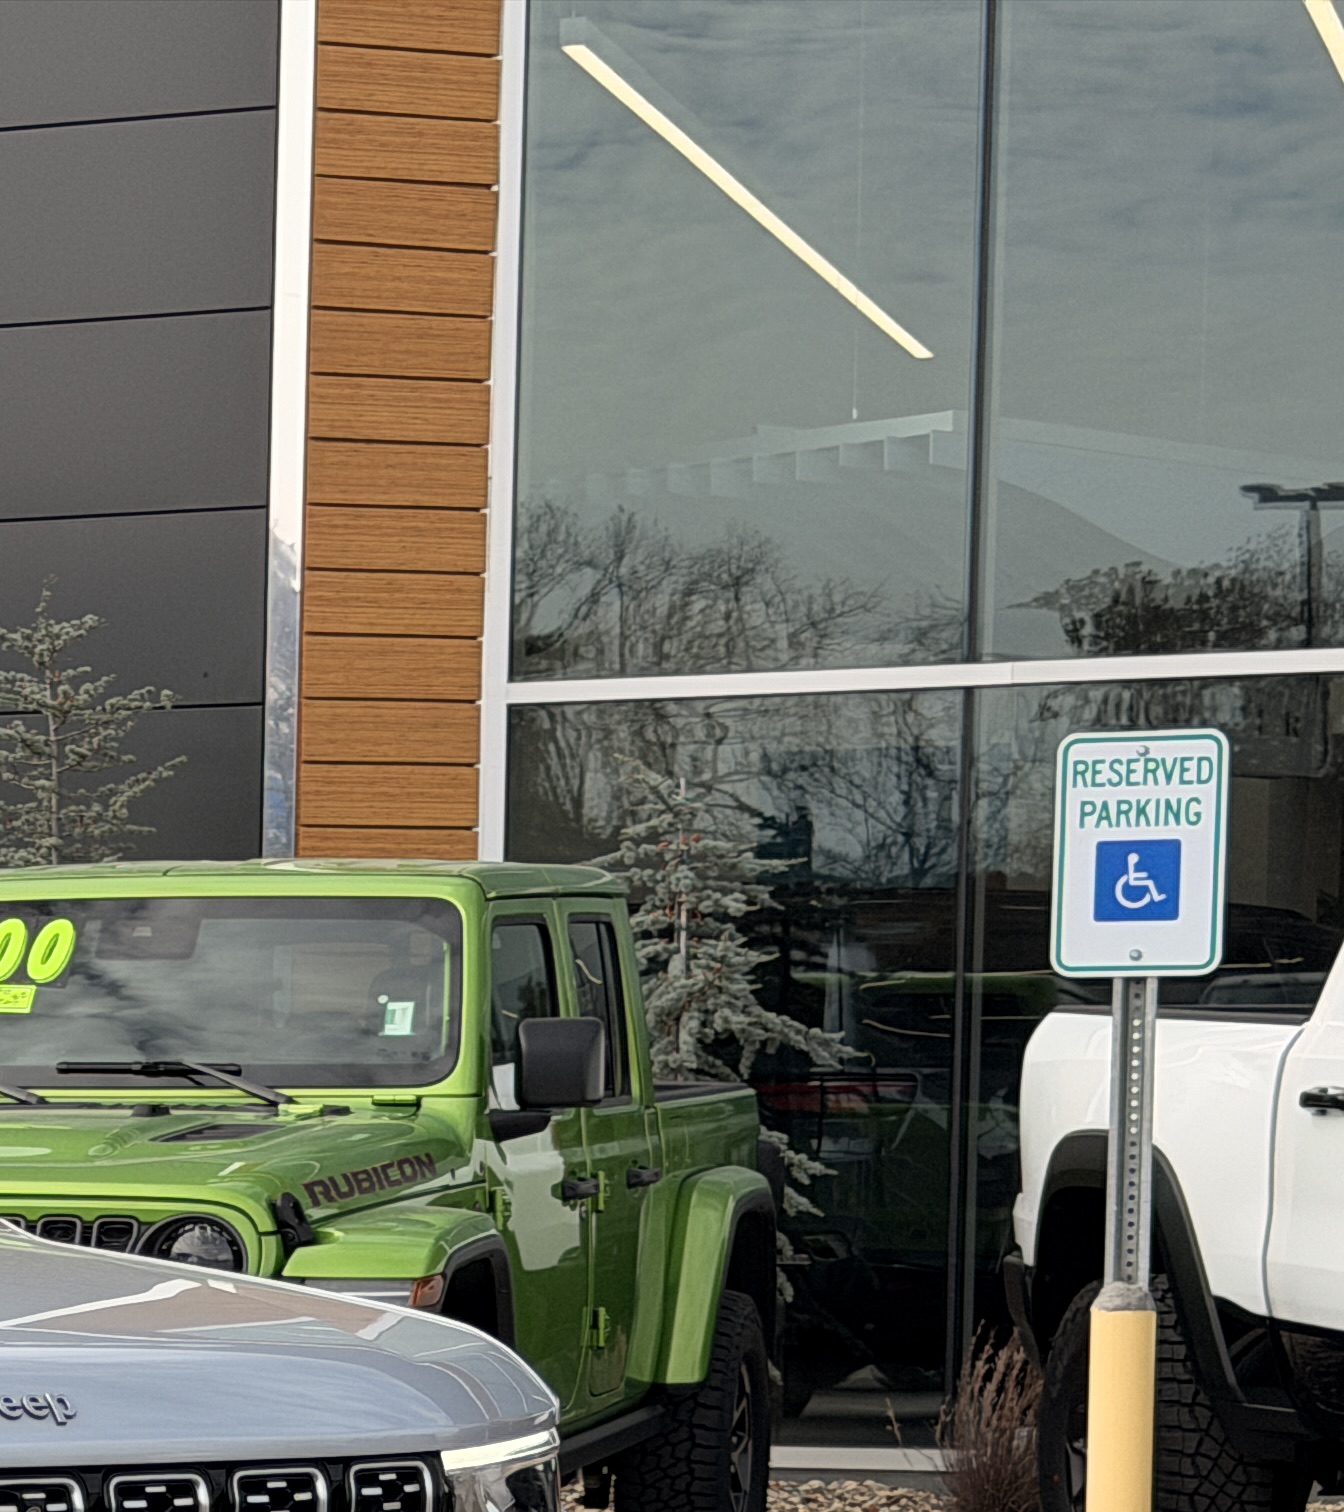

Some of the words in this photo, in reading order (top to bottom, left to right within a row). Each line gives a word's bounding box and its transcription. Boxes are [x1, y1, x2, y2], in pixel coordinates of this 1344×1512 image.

[1072, 755, 1214, 788] RESERVED
[1079, 797, 1202, 829] PARKING
[302, 1152, 438, 1207] RUBICON
